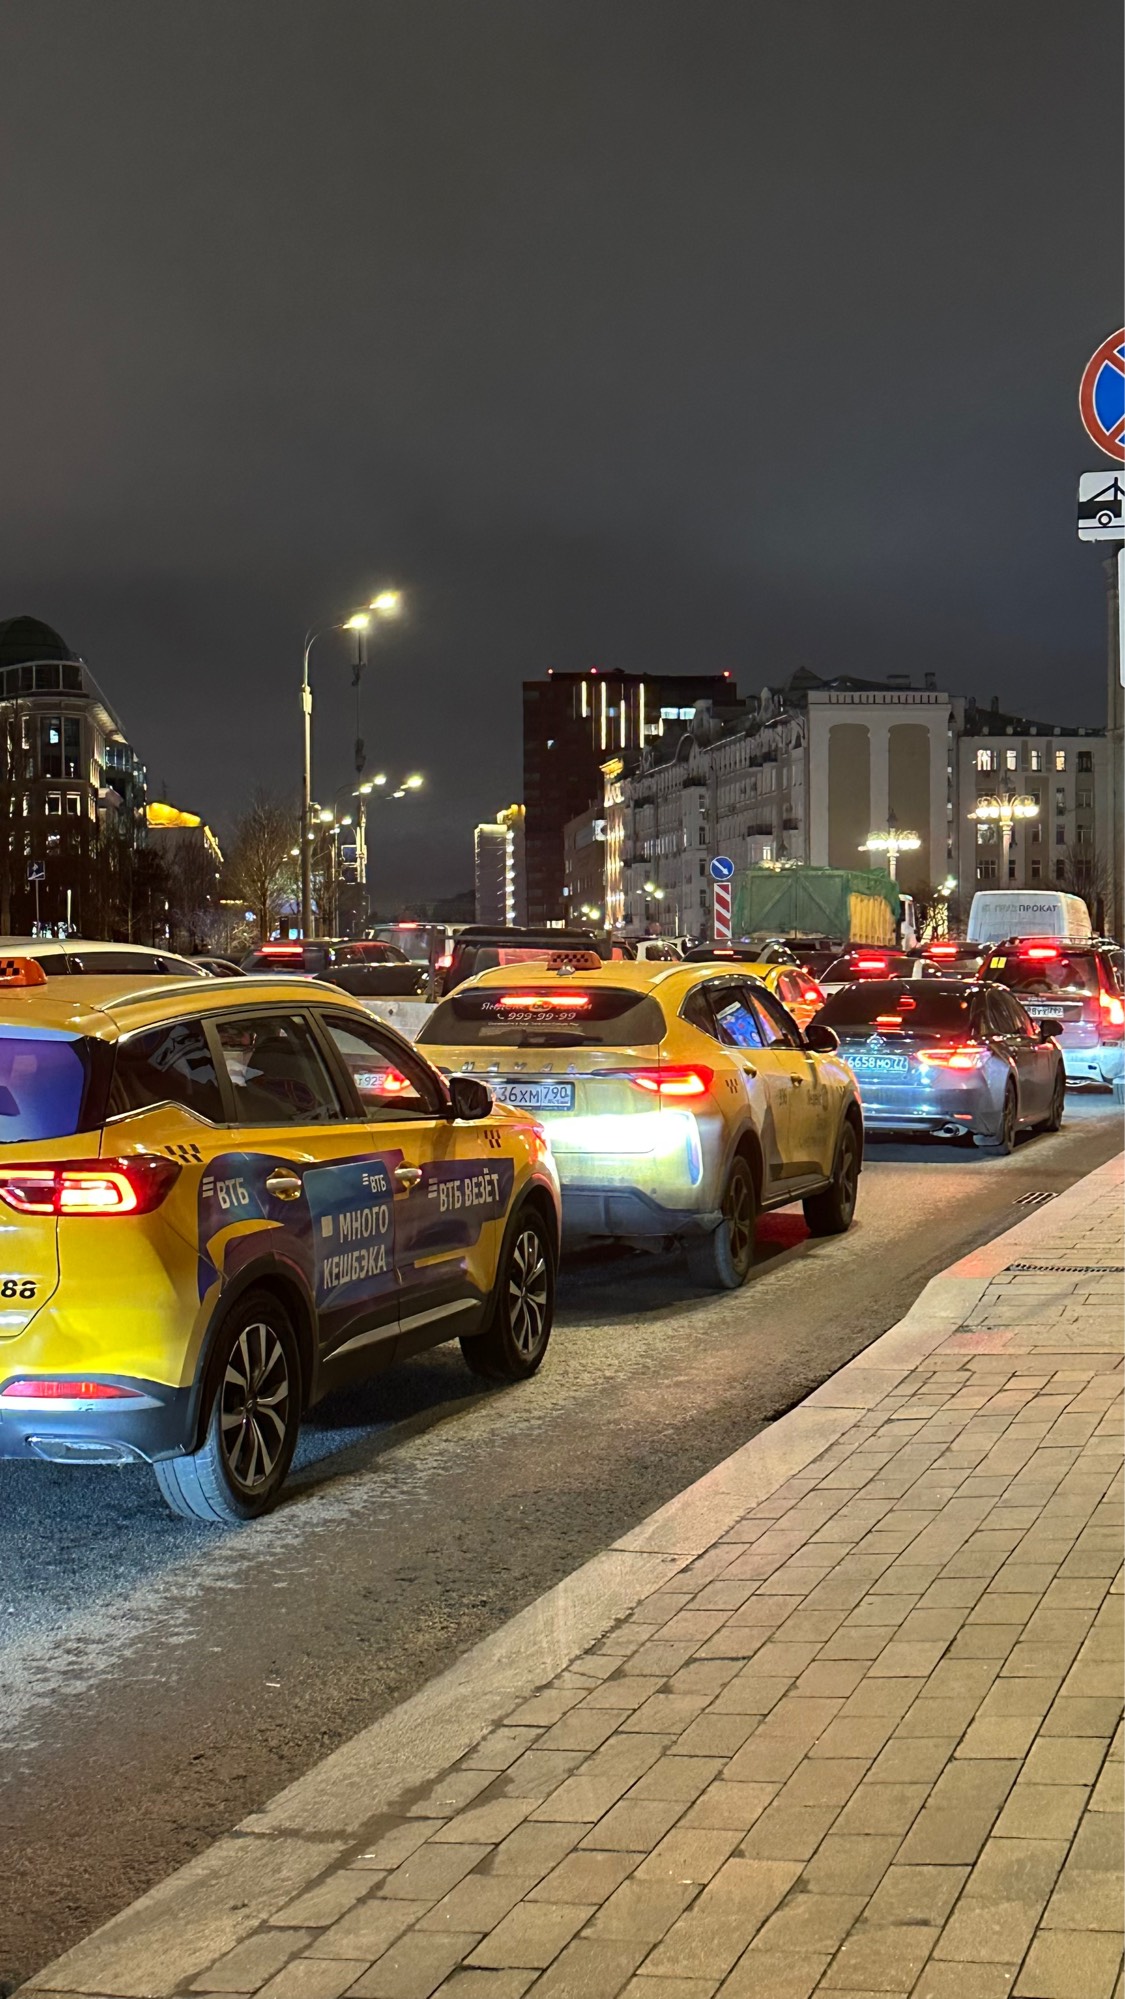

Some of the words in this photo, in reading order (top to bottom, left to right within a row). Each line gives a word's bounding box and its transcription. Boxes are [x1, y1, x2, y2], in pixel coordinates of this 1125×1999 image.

[493, 1086, 540, 1103] 36ХМ
[543, 1086, 568, 1099] 790
[216, 1177, 249, 1209] ВТБ
[370, 1174, 386, 1192] ВТБ
[438, 1180, 462, 1212] ВТБ
[464, 1167, 499, 1207] ВЕЗЁТ
[338, 1204, 389, 1243] МНОГО
[323, 1244, 387, 1289] КЕШБЭКА
